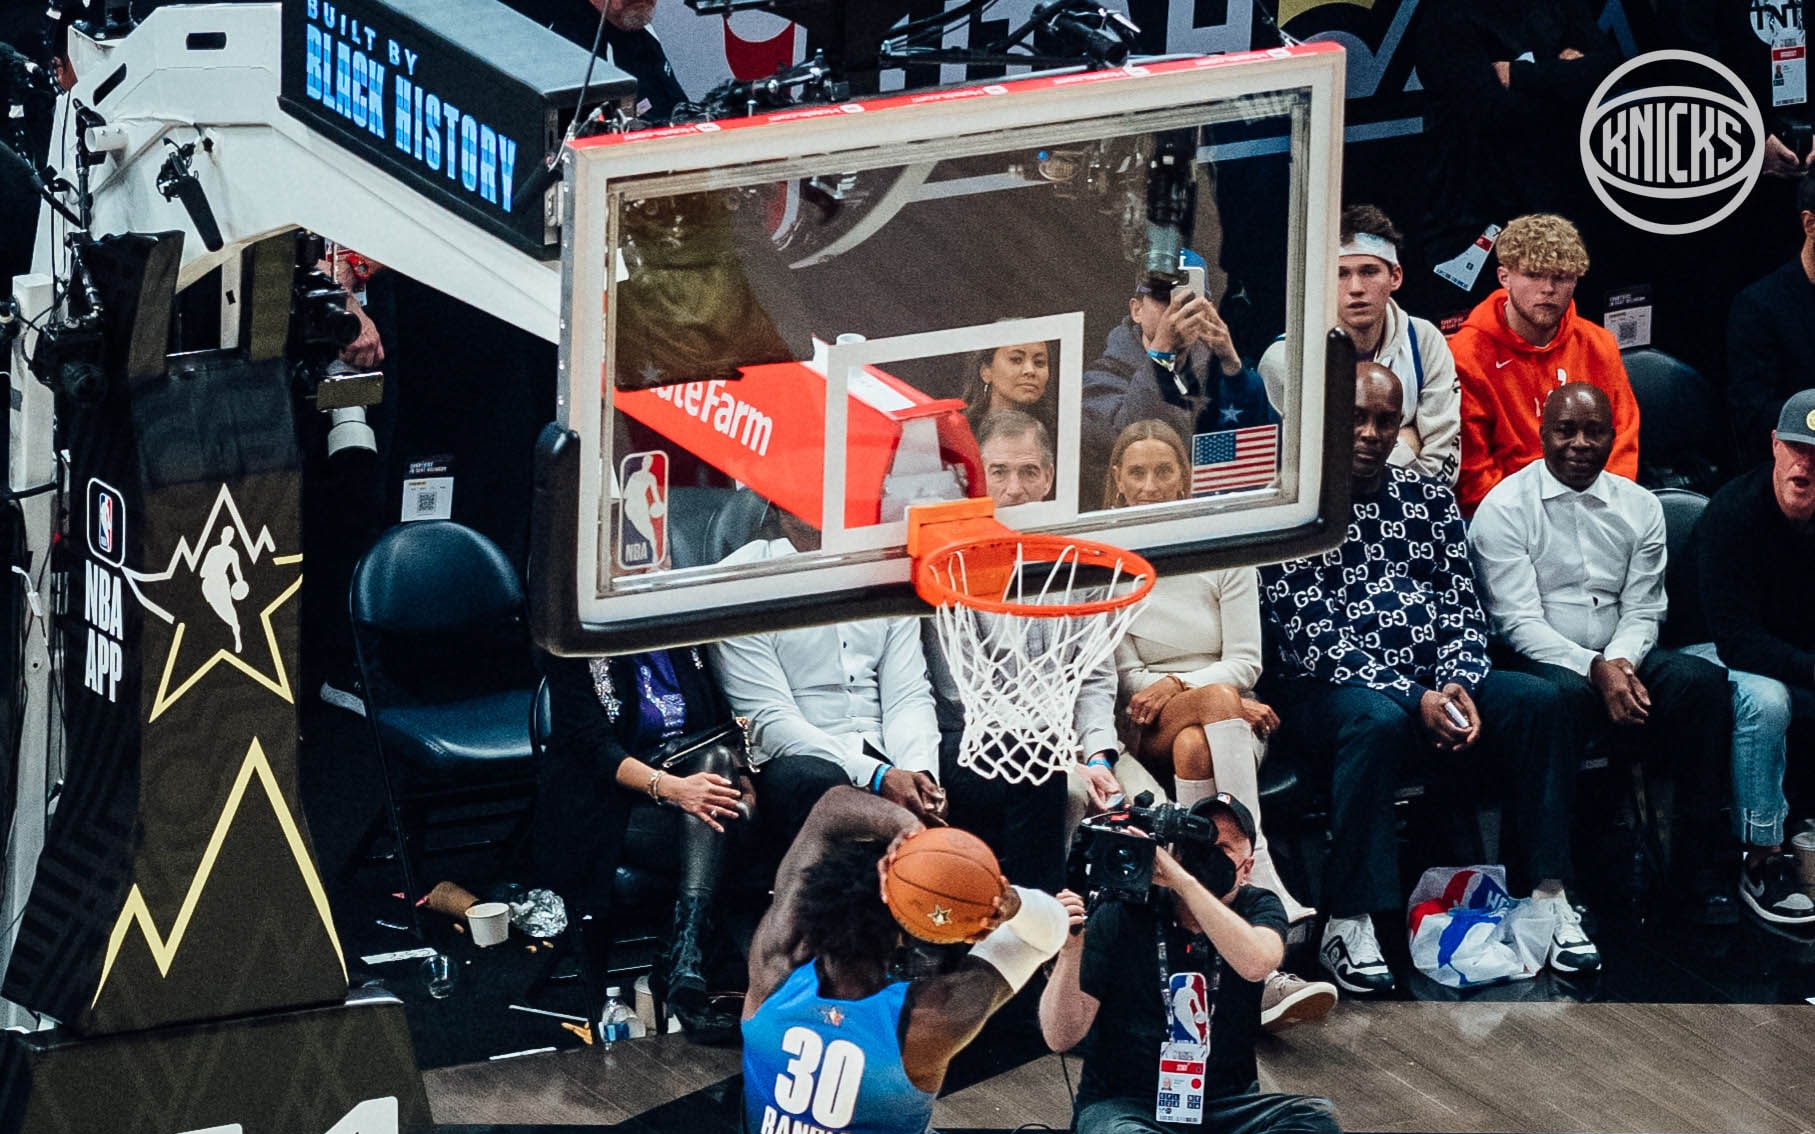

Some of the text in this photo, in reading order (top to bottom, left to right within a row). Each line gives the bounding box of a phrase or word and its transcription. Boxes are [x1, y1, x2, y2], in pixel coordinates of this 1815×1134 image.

[307, 0, 418, 76] BUILT BY
[306, 24, 517, 213] BLACK HISTORY
[625, 542, 648, 562] NBA
[84, 559, 124, 641] NBA
[84, 627, 122, 703] APP
[774, 1026, 866, 1129] 30
